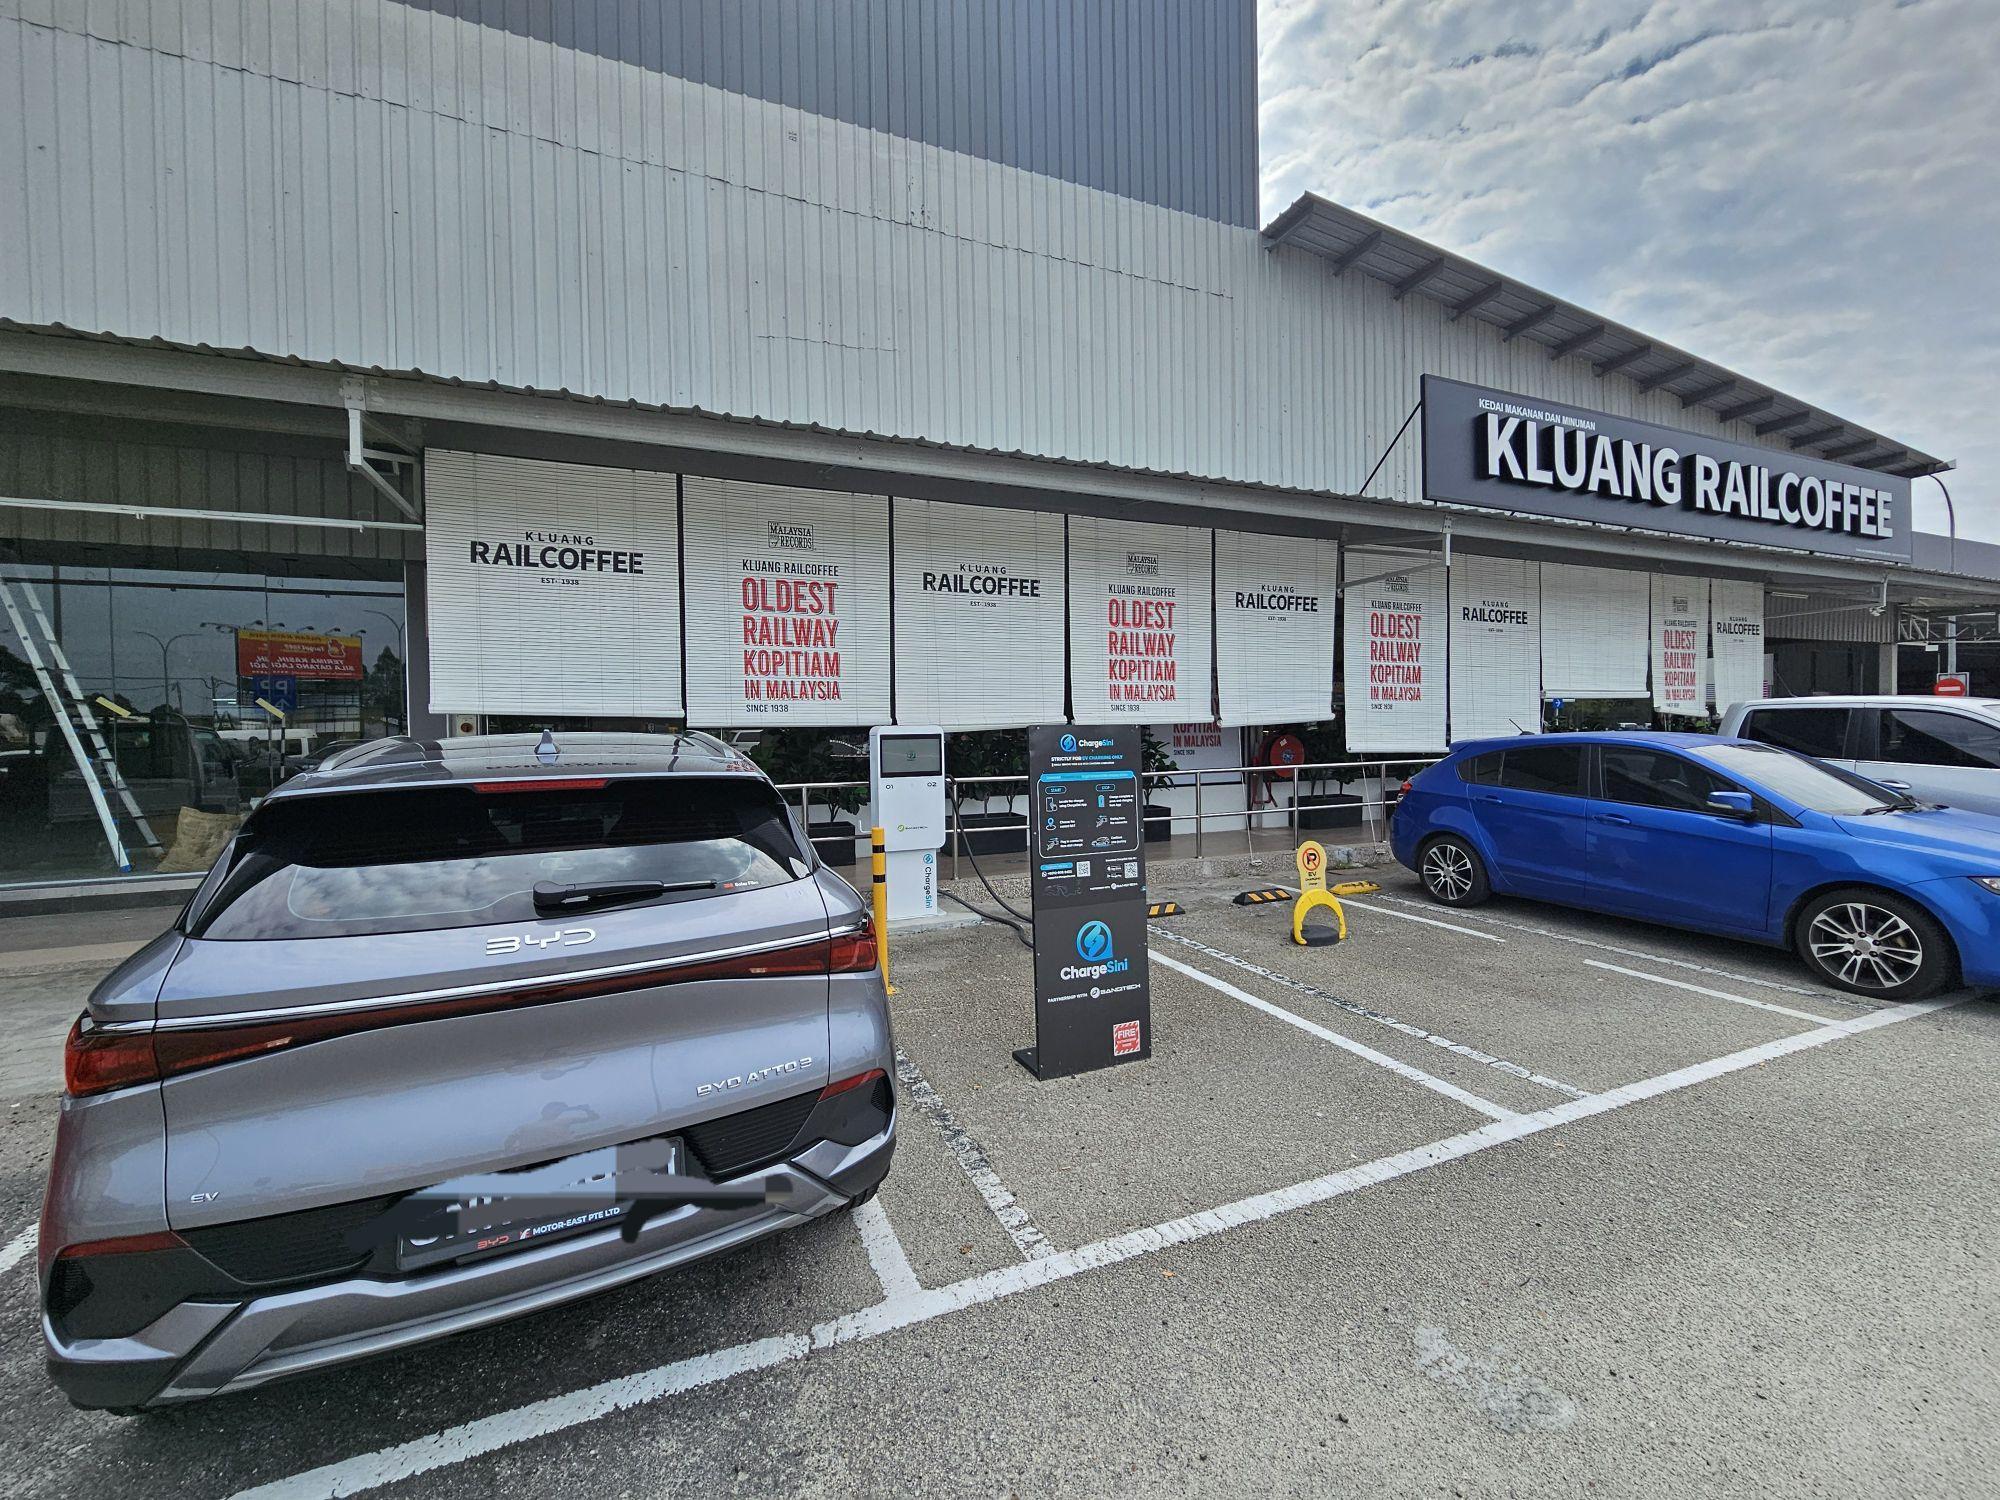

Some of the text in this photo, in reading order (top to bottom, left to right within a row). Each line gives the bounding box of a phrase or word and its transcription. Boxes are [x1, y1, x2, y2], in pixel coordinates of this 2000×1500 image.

[1479, 398, 1596, 430] KEDAI MAKANAN DAN MINUMAN
[1486, 412, 1893, 538] KLUANG RAILCOFFEE
[526, 531, 594, 546] KLUANG
[770, 525, 812, 537] MALAYSIA
[780, 536, 812, 549] RECORDS
[470, 540, 644, 574] RAILCOFFEE
[742, 558, 839, 576] KLUANG RAILCOFFEE
[960, 563, 1007, 574] KLUANG
[922, 572, 1040, 598] RAILCOFFEE
[1108, 584, 1176, 598] KLUANG RAILCOFFEE
[1261, 584, 1295, 594] KLUANG
[742, 577, 838, 615] OLDEST
[1236, 592, 1318, 612] RAILCOFFEE
[1371, 600, 1422, 612] KLUANG RAILCOFFEE
[1108, 598, 1176, 630] OLDEST
[1462, 606, 1528, 624] RAILCOFFEE
[743, 614, 839, 648] RAILWAY
[1370, 612, 1422, 640] OLDEST
[1716, 622, 1760, 636] RAILCOFFEE
[1108, 630, 1176, 658] RAILWAY
[1664, 630, 1696, 650] OLDEST
[1370, 640, 1421, 663] RAILWAY
[1664, 652, 1696, 669] RAILWAY
[744, 650, 840, 678] KOPITIAM
[1109, 658, 1176, 682] KOPITIAM
[1370, 664, 1422, 684] KOPITIAM
[1664, 672, 1696, 686] KOPITIAM
[744, 680, 841, 700] IN MALAYSIA
[1110, 684, 1176, 701] IN MALAYSIA
[1370, 686, 1421, 701] IN MALAYSIA
[746, 704, 789, 712] SINCE 1938
[1078, 739, 1114, 748] ChargeSini
[1174, 735, 1222, 748] IN MALAYSIA
[924, 866, 932, 908] ChargeSini
[486, 928, 596, 956] BYD
[1060, 958, 1128, 980] ChargeSini
[1118, 1029, 1136, 1039] FIRE
[696, 1056, 812, 1096] BYD ATTO 3
[190, 1191, 220, 1204] EV
[477, 1207, 621, 1249] BYD MOTOR-EAST PTE LTD
